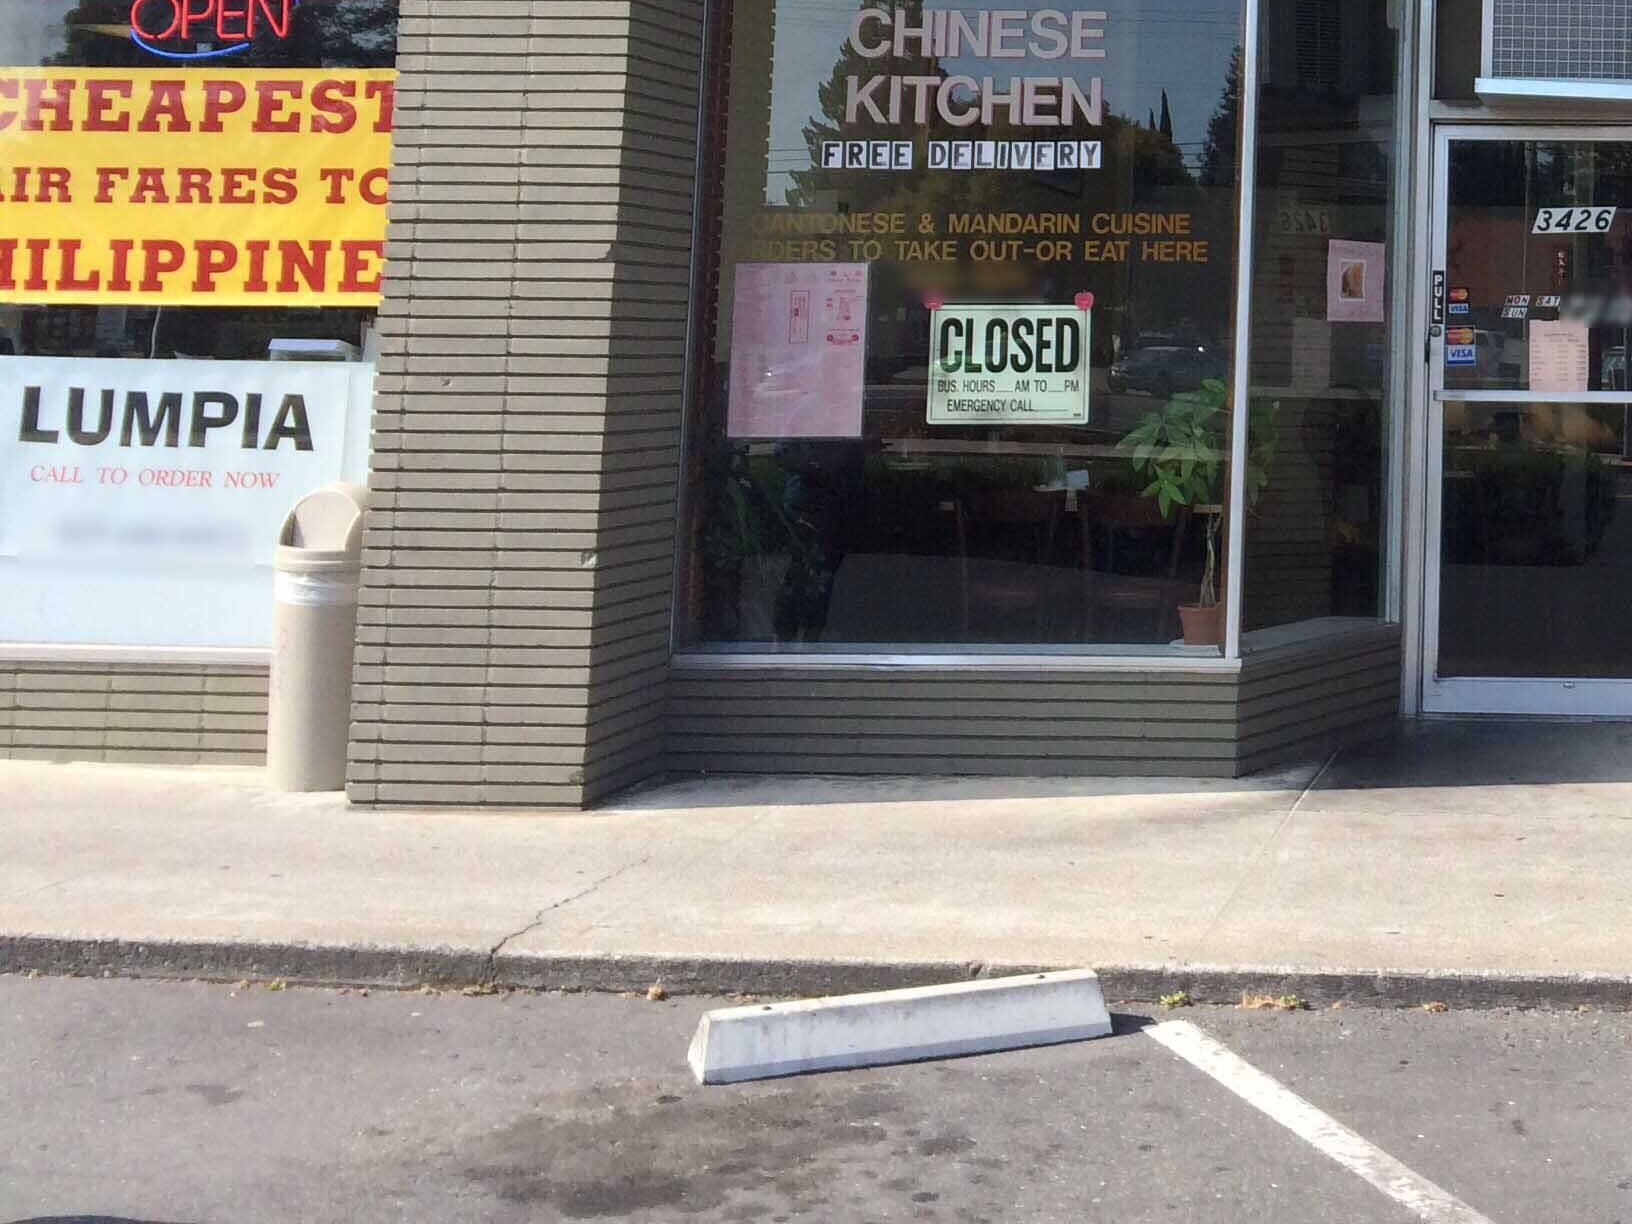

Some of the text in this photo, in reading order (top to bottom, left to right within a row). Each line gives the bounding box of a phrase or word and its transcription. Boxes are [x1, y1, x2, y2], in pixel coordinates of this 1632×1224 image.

[849, 8, 1108, 61] CHINESE
[844, 74, 1104, 128] KITCHEN
[823, 142, 1101, 169] FREE DELIVERY
[0, 167, 72, 203] IR
[94, 167, 299, 204] FARES
[918, 213, 935, 234] &
[948, 213, 1080, 235] MANDARIN
[1092, 213, 1191, 235] CUISINE
[1537, 209, 1612, 232] 3426
[732, 240, 1208, 263] DERS TO TAKE OUT-OR EAT HERE
[1434, 274, 1443, 321] PULL
[939, 317, 1080, 373] CLOSED
[1451, 349, 1473, 358] VISA
[963, 380, 996, 393] HOURS
[1015, 380, 1030, 392] AM
[1035, 380, 1048, 392] TO
[1064, 380, 1080, 393] PM
[947, 399, 1034, 412] EMERGENCY CALL
[18, 386, 314, 451] LUMPIA
[29, 466, 281, 489] CALL TO ORDER NOW
